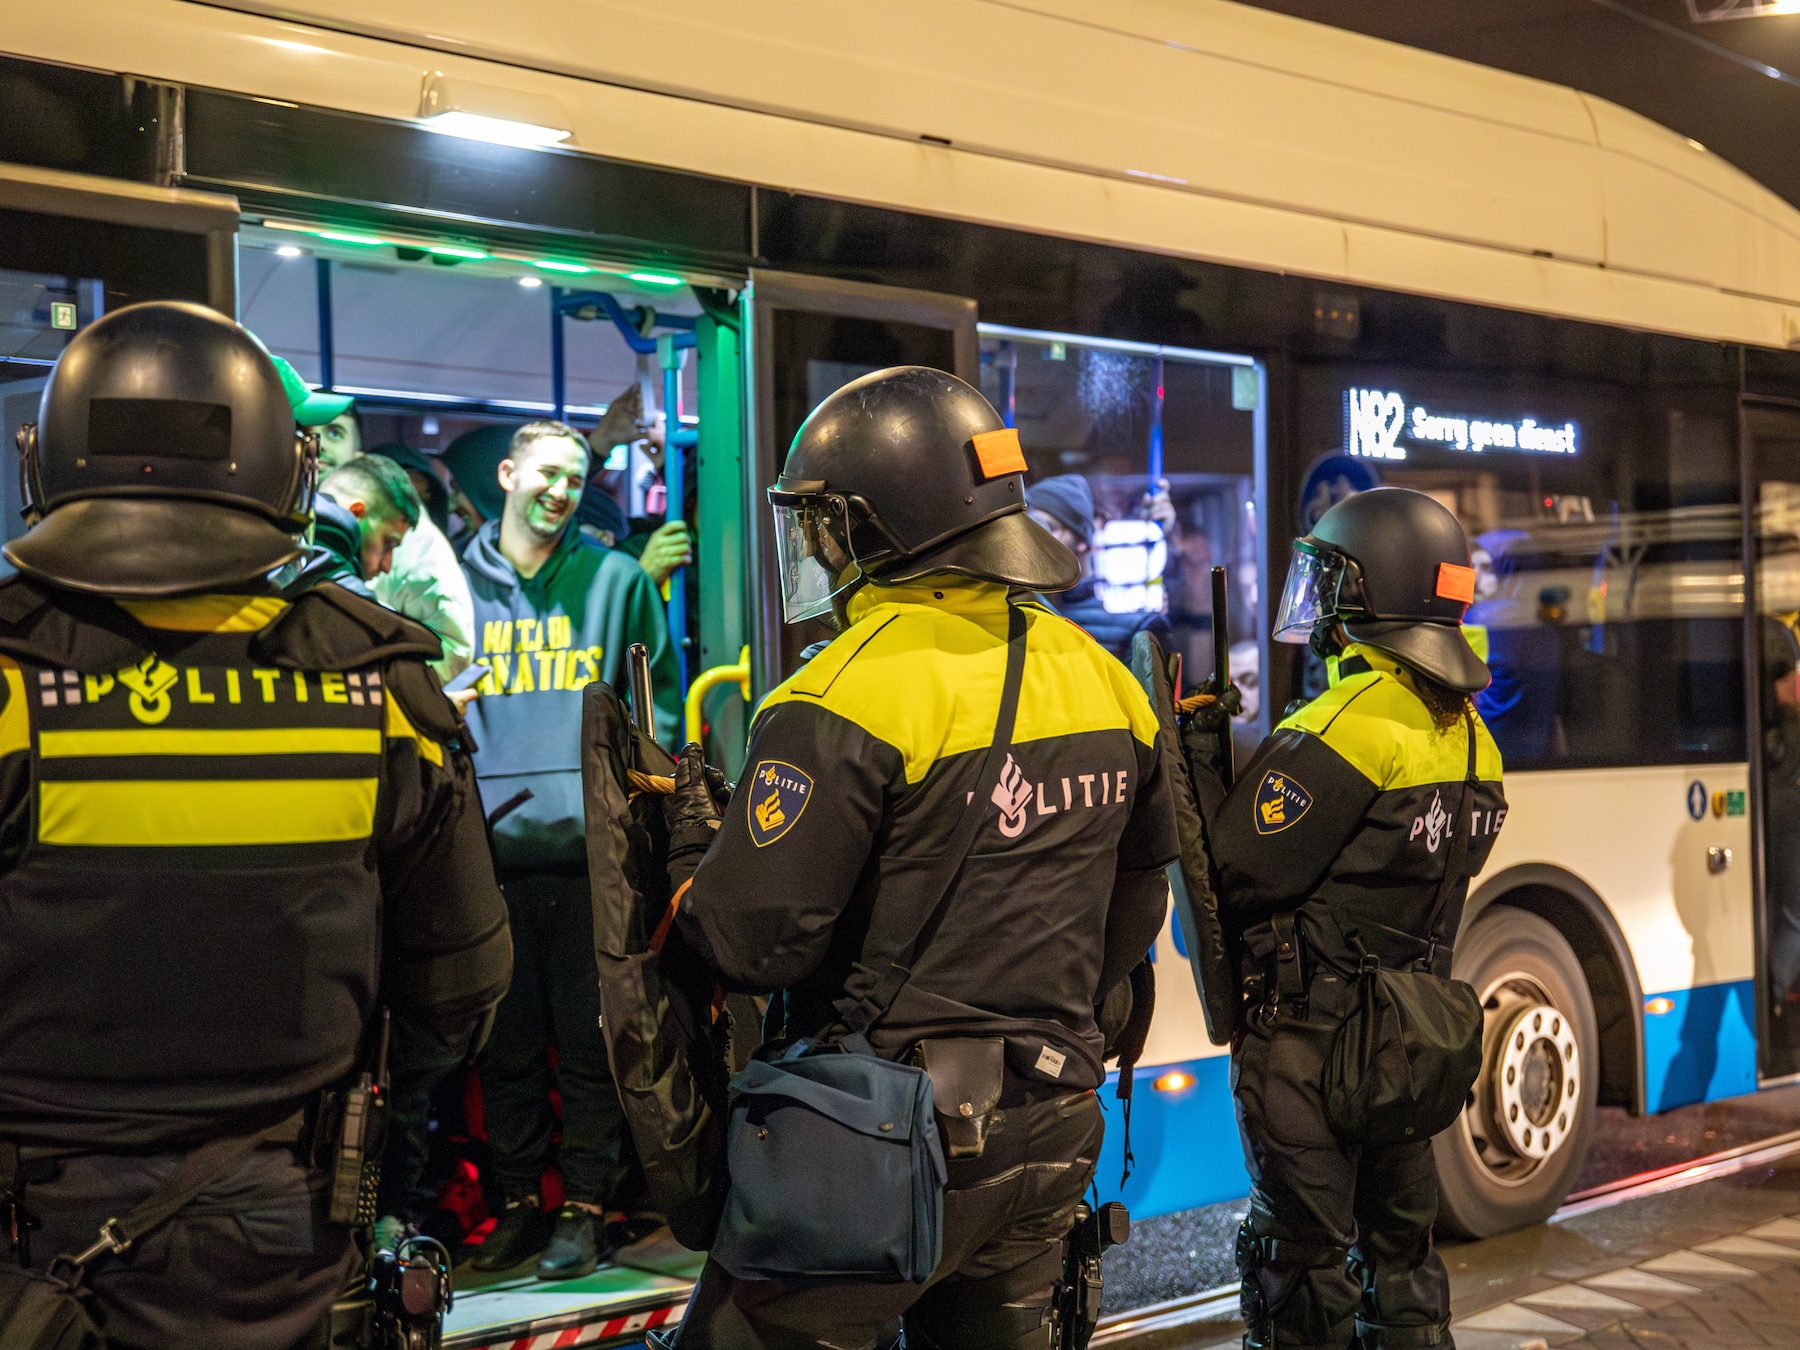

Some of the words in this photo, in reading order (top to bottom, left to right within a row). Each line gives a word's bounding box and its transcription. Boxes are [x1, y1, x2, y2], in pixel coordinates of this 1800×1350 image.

[1411, 406, 1468, 450] Sorry
[1469, 420, 1517, 452] geen
[1518, 418, 1576, 454] dienst
[483, 615, 572, 654] MACABI
[476, 645, 603, 696] ANATICS
[84, 668, 350, 725] POLITIE
[758, 769, 807, 795] POLITIE
[966, 770, 1128, 838] OLITIE
[1267, 776, 1308, 808] POLITIE
[1409, 808, 1507, 854] POLTIE
